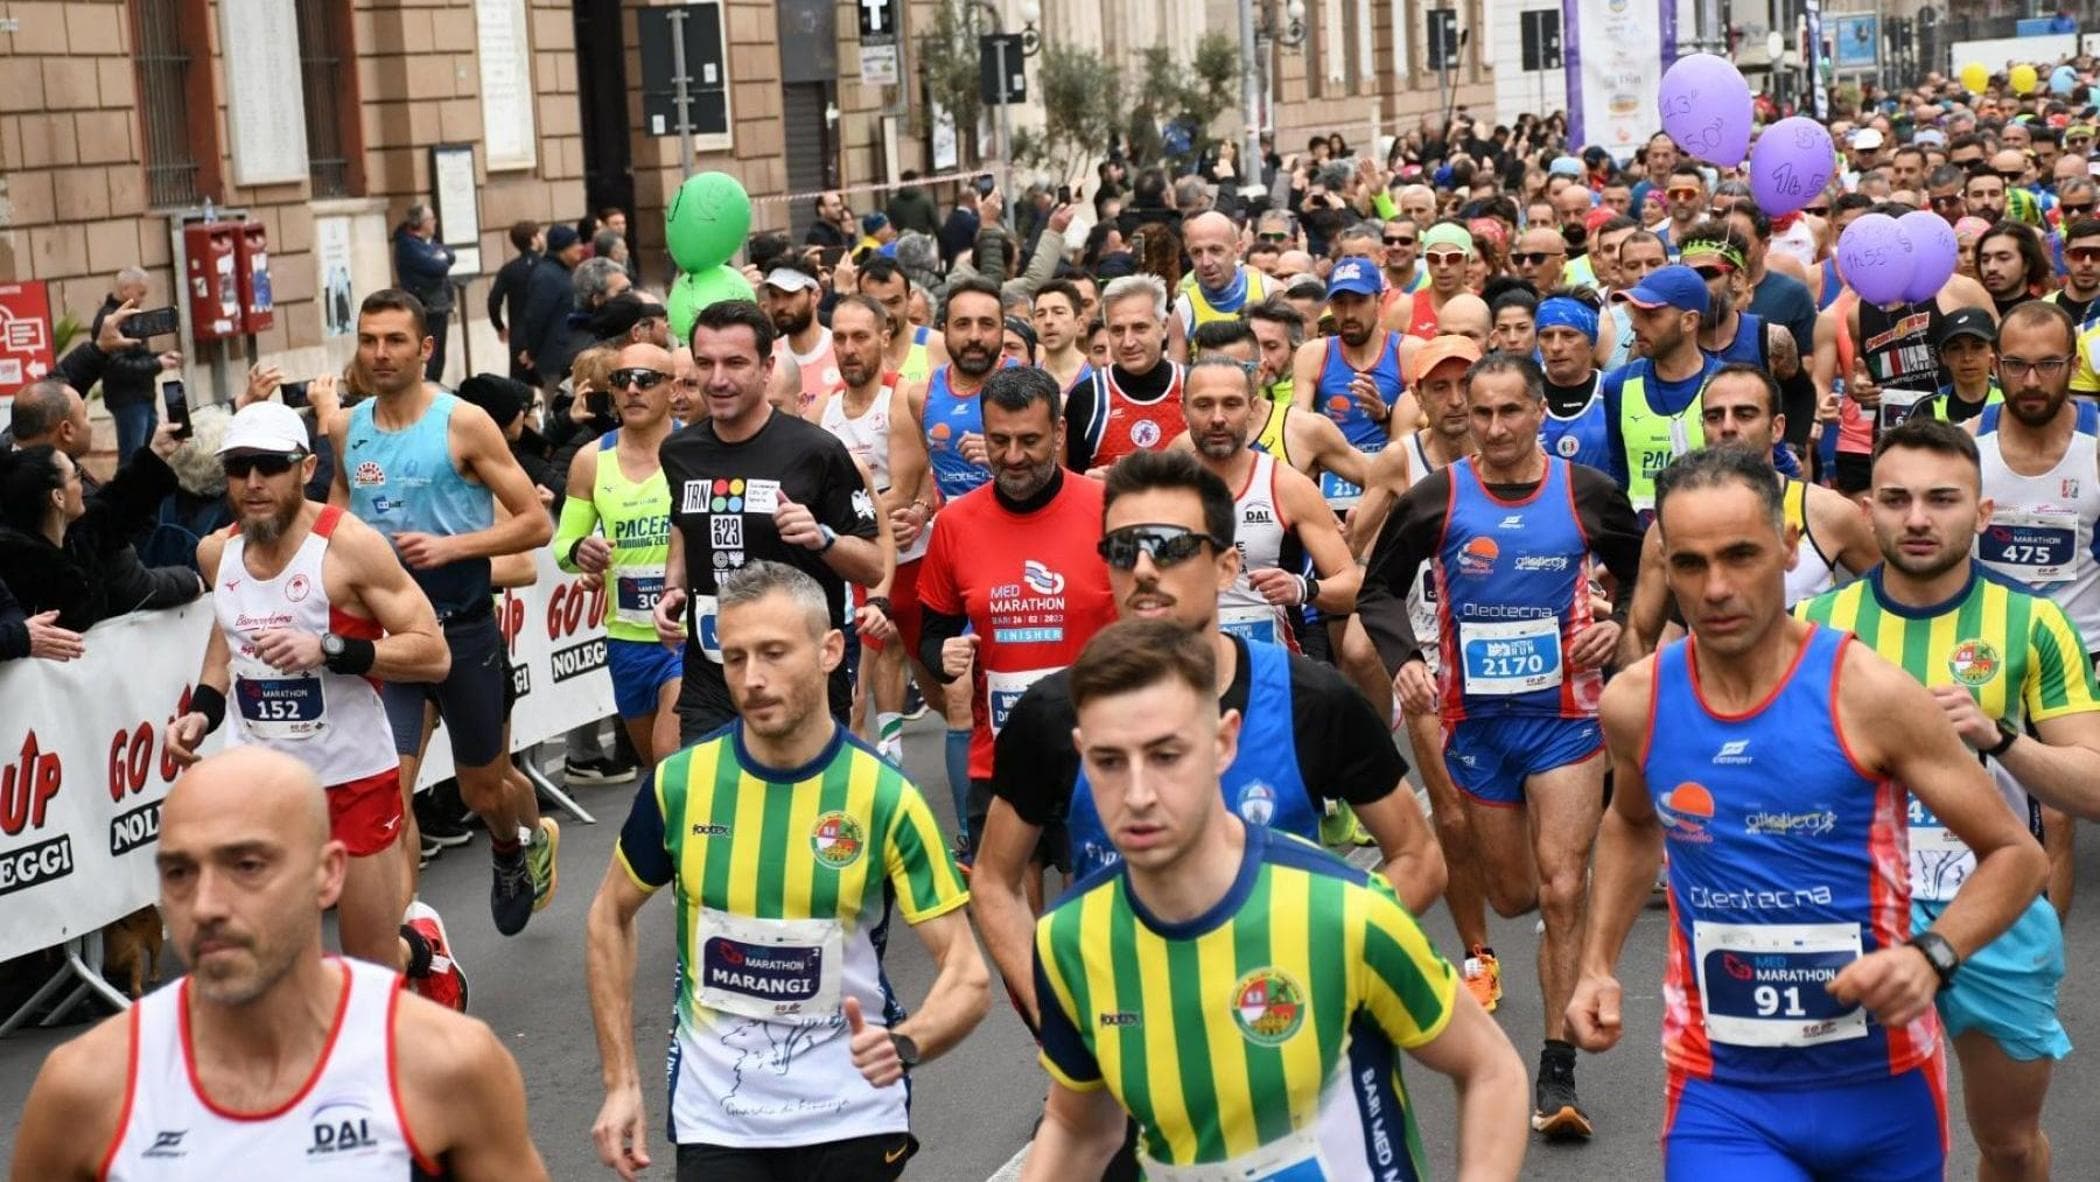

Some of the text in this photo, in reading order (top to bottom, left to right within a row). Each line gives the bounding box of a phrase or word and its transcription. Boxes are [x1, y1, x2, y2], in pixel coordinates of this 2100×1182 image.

[685, 481, 710, 512] TRN
[2003, 545, 2050, 563] 475
[991, 585, 1019, 599] MED
[547, 580, 584, 641] GO
[990, 598, 1064, 613] MARATHON
[552, 642, 607, 679] NOLEG
[1482, 655, 1543, 675] 2170
[257, 701, 300, 719] 152
[109, 721, 154, 803] GO
[744, 956, 804, 970] MARATHON
[711, 968, 811, 993] MARANGI
[1756, 969, 1835, 982] MARATHON
[1754, 986, 1806, 1016] 91
[1361, 1068, 1379, 1117] BARI
[1372, 1118, 1393, 1167] MED
